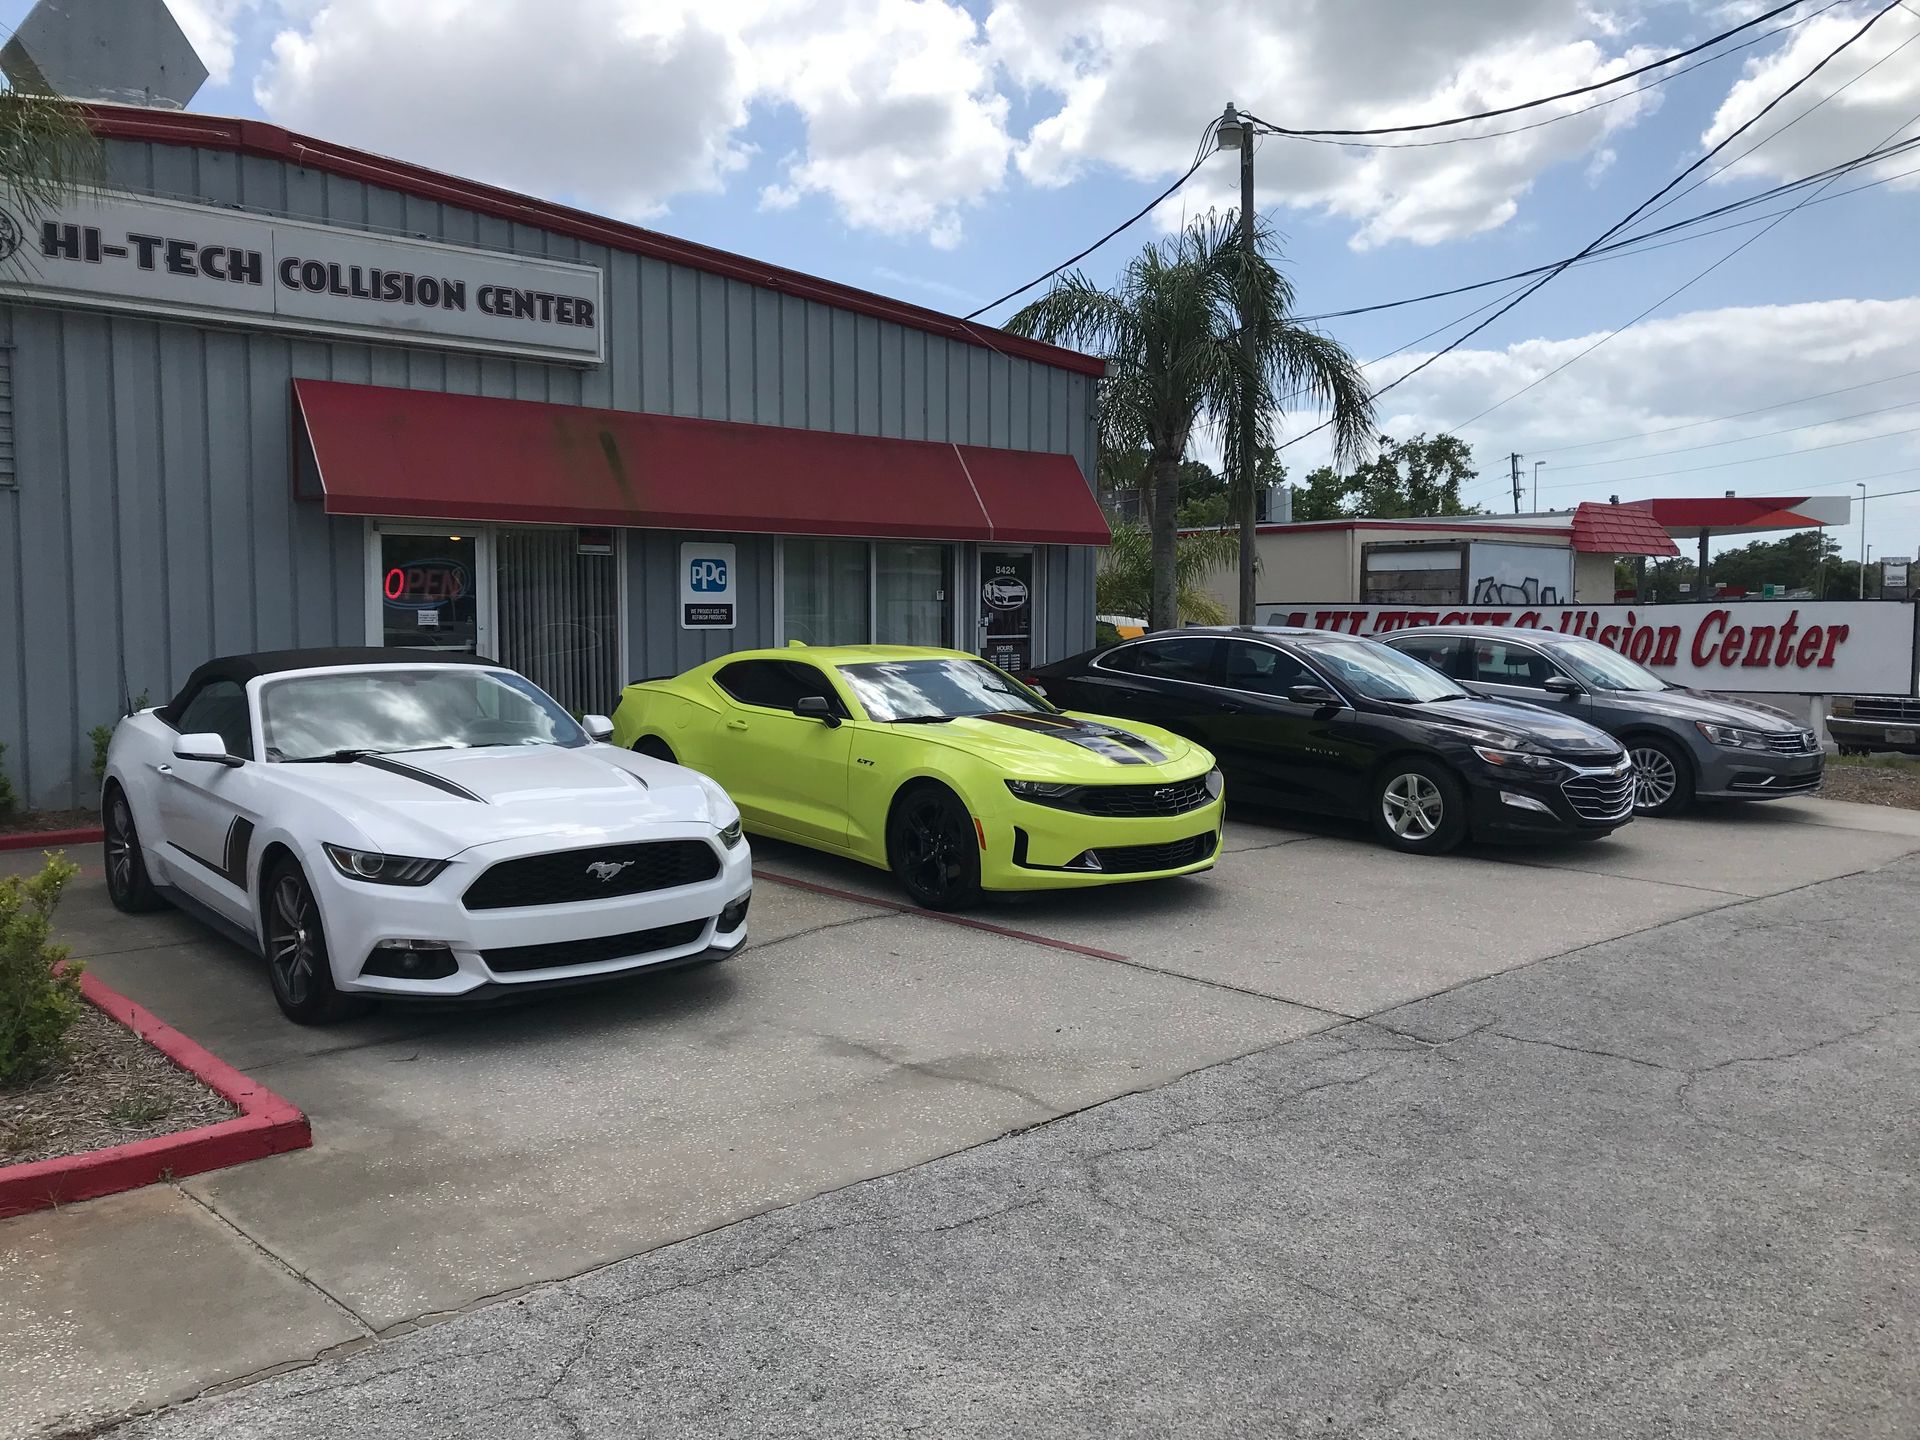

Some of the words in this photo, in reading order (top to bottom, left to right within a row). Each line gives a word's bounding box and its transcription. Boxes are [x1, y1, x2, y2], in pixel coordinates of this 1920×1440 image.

[41, 220, 263, 286] HI-TECH
[278, 256, 466, 312] COLLISION
[476, 284, 595, 328] CENTER
[385, 568, 460, 600] OPEN
[692, 561, 726, 589] PPG
[995, 566, 1016, 574] 8424
[1691, 610, 1849, 668] Center
